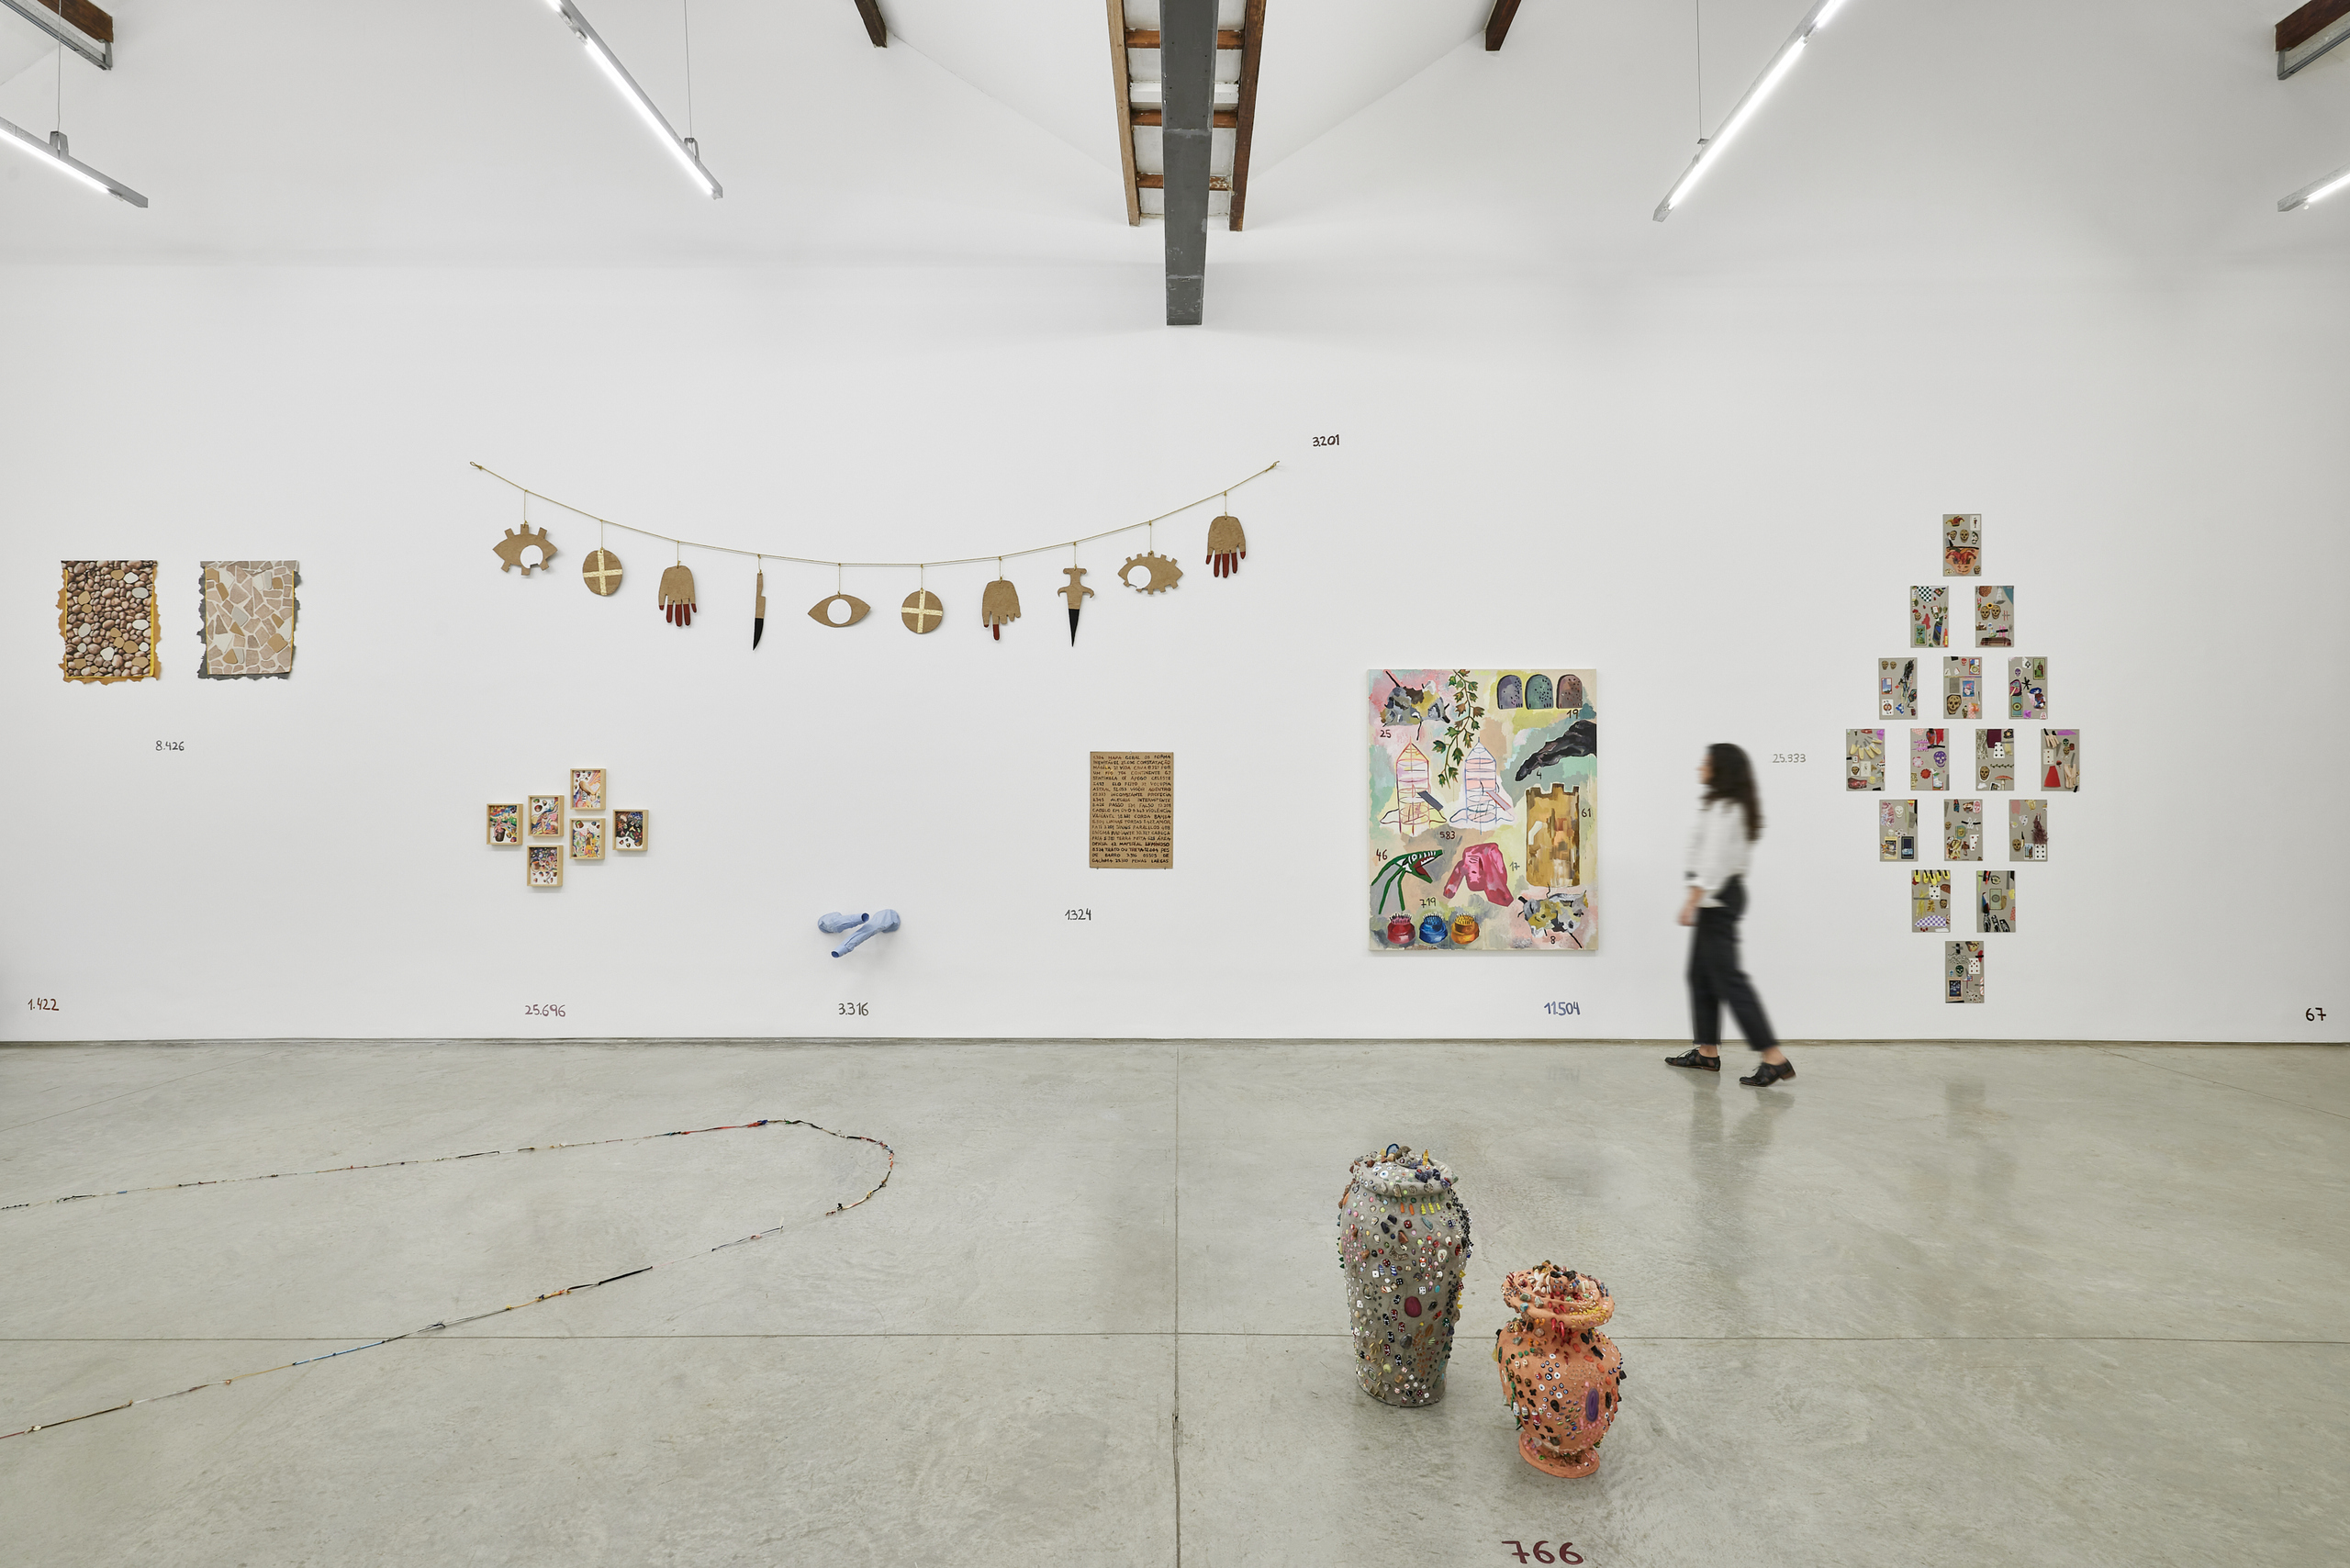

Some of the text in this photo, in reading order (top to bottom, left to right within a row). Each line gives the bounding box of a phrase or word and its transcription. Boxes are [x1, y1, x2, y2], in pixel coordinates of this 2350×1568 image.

[1312, 433, 1340, 448] 3.201
[1566, 709, 1579, 720] 19
[1380, 729, 1392, 738] 25
[155, 739, 185, 752] 8.426
[1772, 752, 1807, 764] 25.333
[1536, 770, 1542, 780] 4
[1581, 808, 1592, 818] 61
[1439, 830, 1456, 840] 583
[1376, 848, 1388, 861] 46
[1509, 861, 1520, 872] 17
[1550, 935, 1556, 945] 8
[27, 997, 60, 1012] 1.422
[523, 1002, 566, 1018] 25.696
[837, 1002, 869, 1017] 3.316
[1543, 1001, 1581, 1016] 11.504
[2305, 1007, 2327, 1021] 67
[1501, 1540, 1584, 1565] 766
